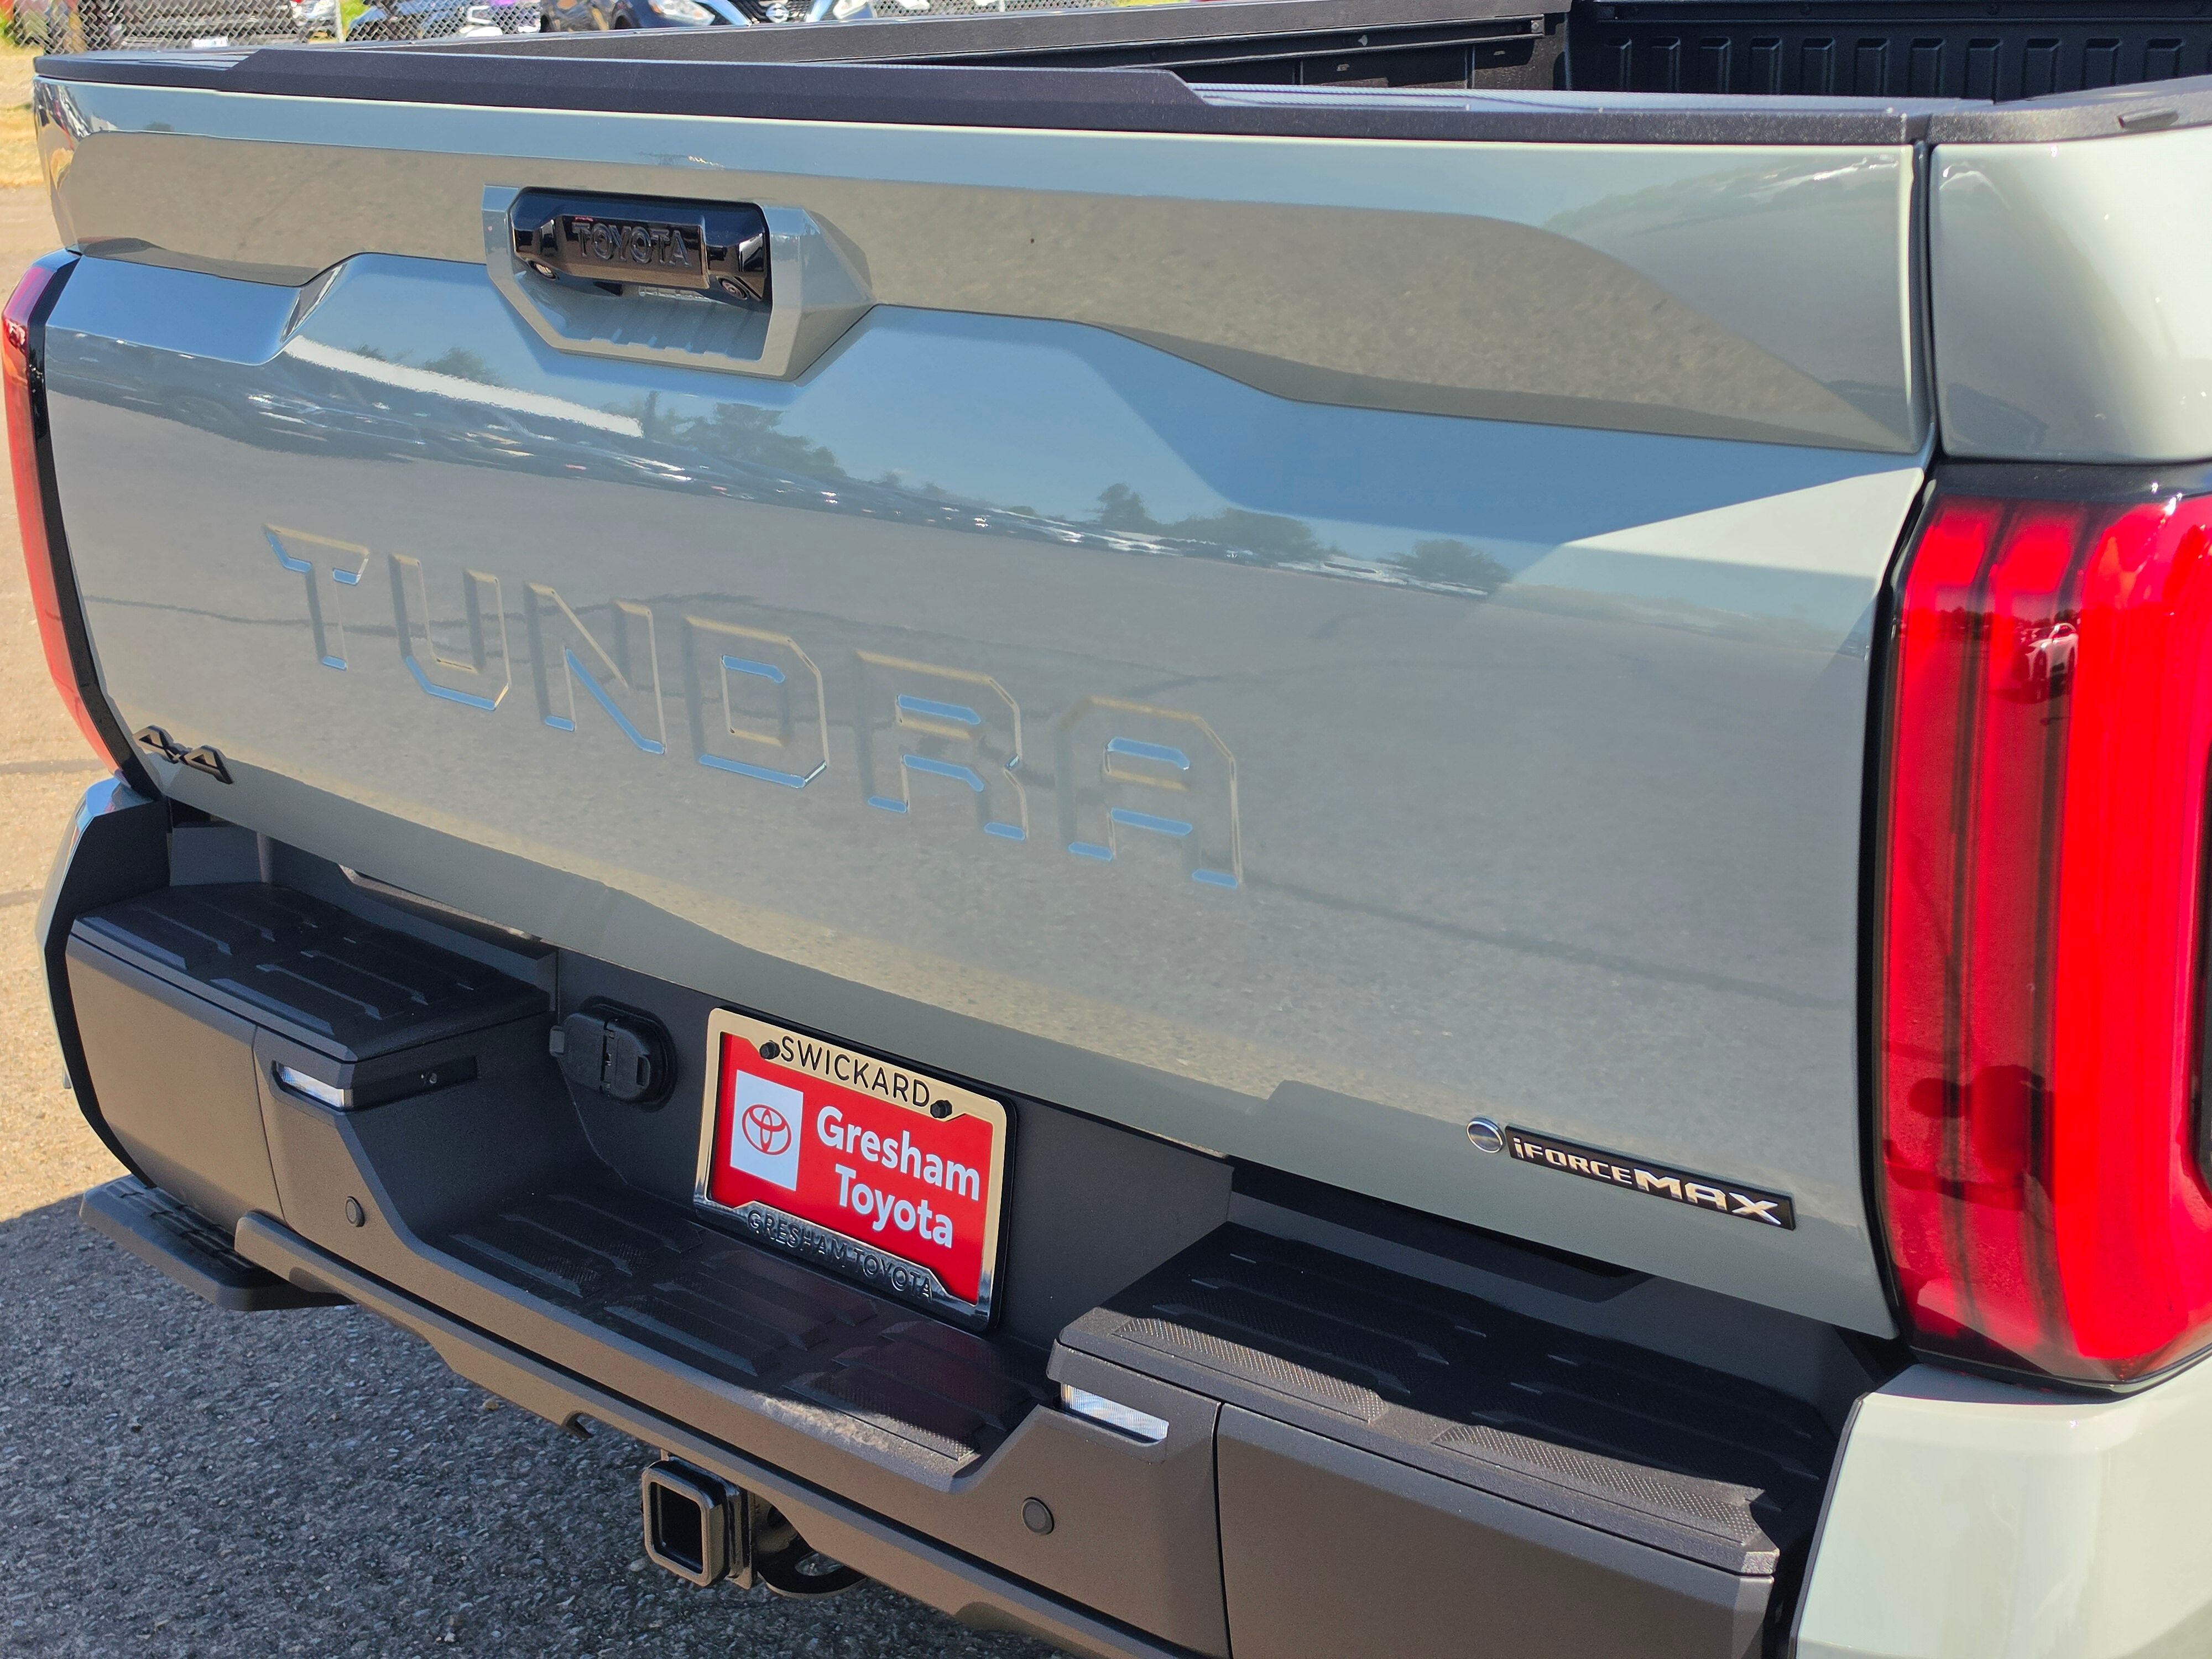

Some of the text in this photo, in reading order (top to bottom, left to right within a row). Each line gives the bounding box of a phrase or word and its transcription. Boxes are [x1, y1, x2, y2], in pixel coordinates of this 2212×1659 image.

[572, 222, 692, 268] TOYOTA
[264, 524, 1242, 889] TUNDRA
[780, 1035, 930, 1108] SWICKARD
[816, 1105, 980, 1202] Gresham
[835, 1164, 953, 1249] Toyota
[747, 1209, 933, 1303] GRESHAM TOYOTA
